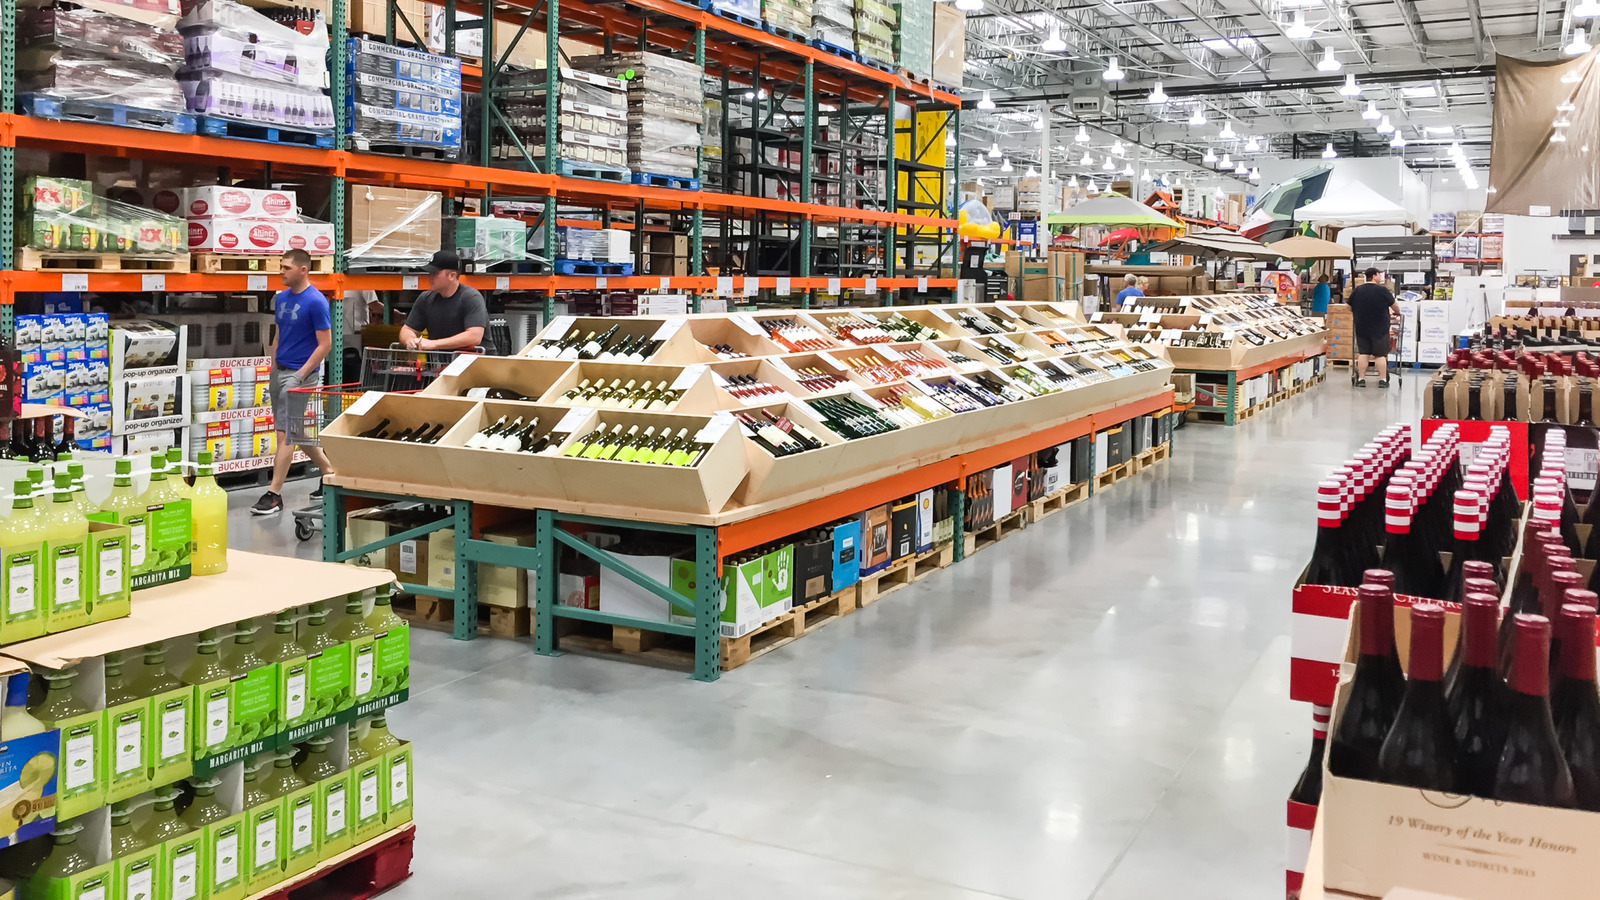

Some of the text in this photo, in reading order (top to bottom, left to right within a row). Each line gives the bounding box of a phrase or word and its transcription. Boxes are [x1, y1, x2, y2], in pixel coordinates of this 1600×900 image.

[266, 196, 287, 207] Shiner
[220, 358, 252, 368] BUCKLE
[253, 358, 264, 366] UP
[123, 367, 178, 379] pop-up organizer
[221, 409, 252, 420] BUCKLE
[253, 408, 264, 417] UP
[125, 422, 150, 431] pop-up
[151, 417, 183, 428] organizer
[218, 460, 250, 471] BUCKLE
[252, 459, 262, 467] UP
[168, 568, 180, 579] MIX
[1322, 585, 1359, 597] SEAS
[357, 694, 399, 716] MARGARITA MIX
[289, 716, 336, 740] MARGARITA MIX
[210, 741, 264, 768] MARGARITA MIX
[1388, 815, 1577, 855] 19 Winery of the Year Honors
[1422, 852, 1451, 864] WINE
[1454, 858, 1462, 866] &
[1466, 860, 1509, 874] SPIRITS
